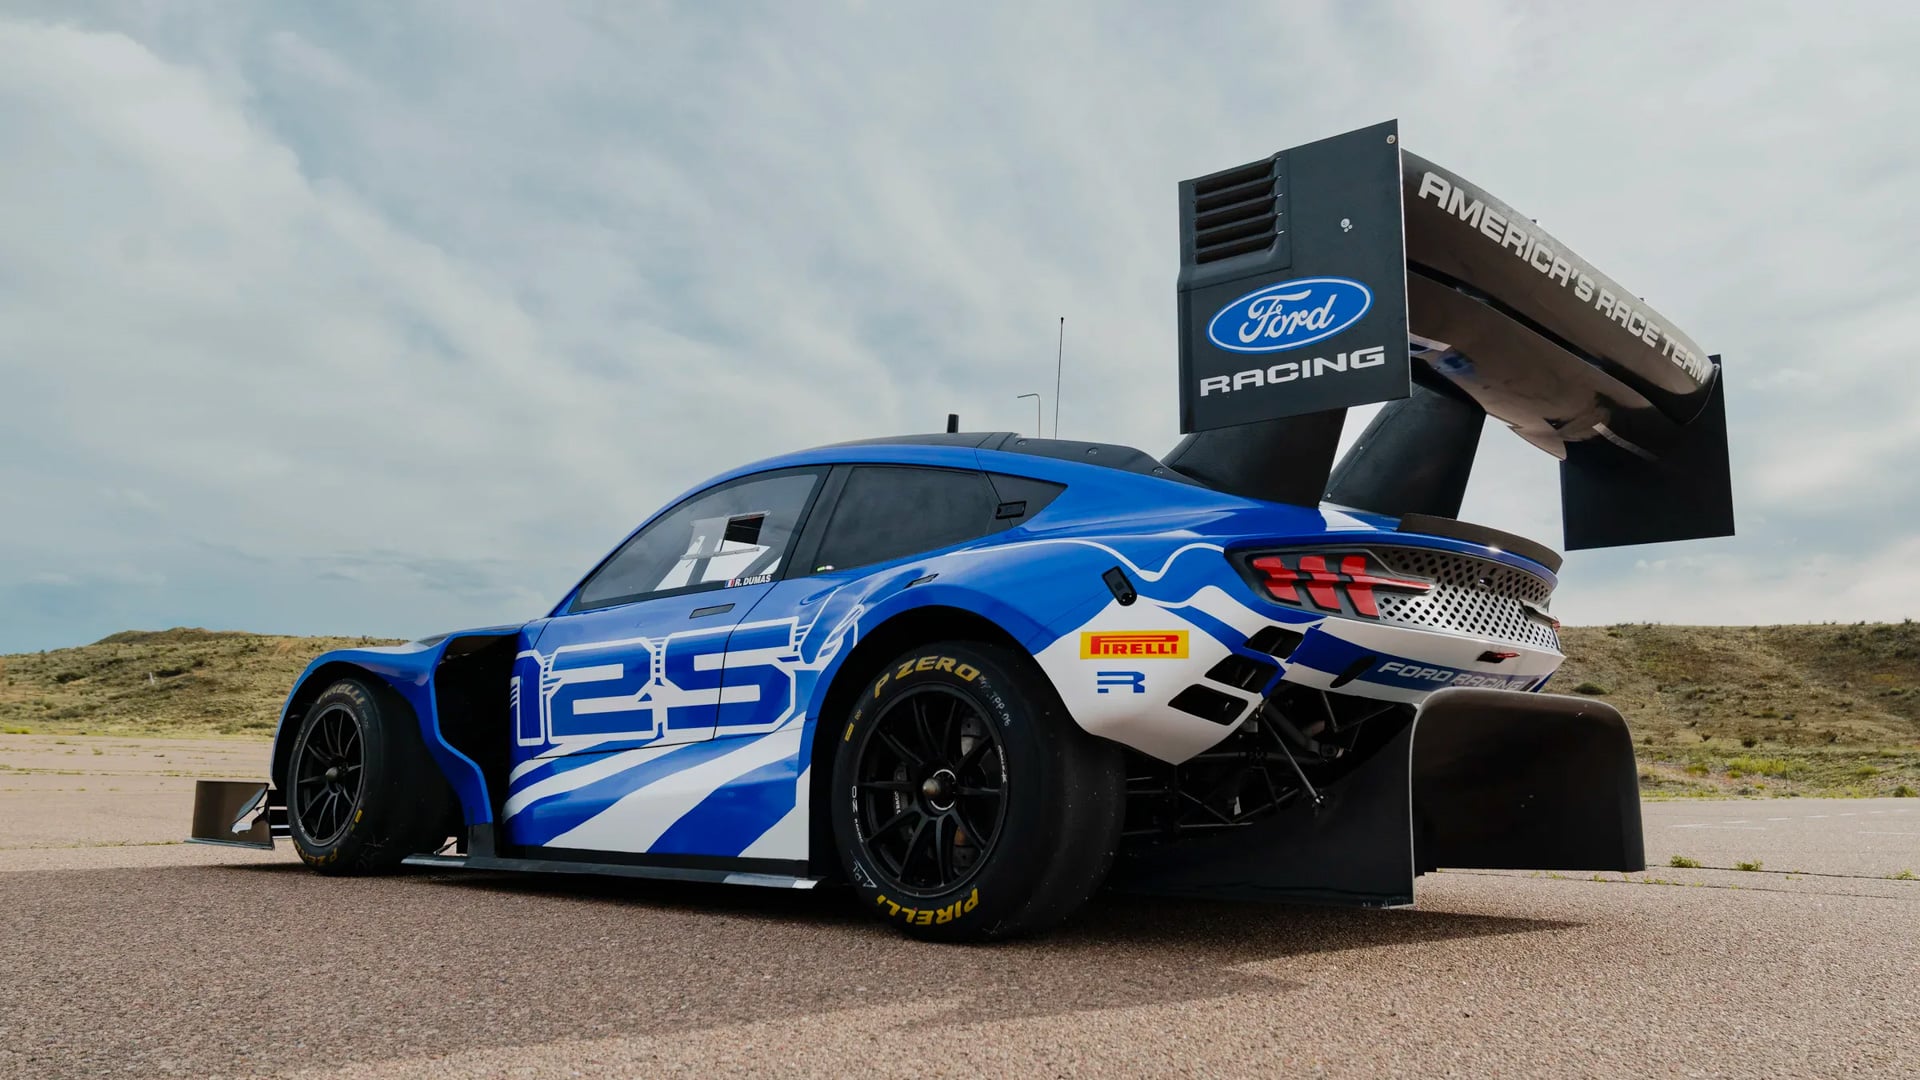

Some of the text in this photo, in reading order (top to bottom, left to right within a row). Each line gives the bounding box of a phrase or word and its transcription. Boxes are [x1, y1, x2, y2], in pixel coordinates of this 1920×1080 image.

[1418, 171, 1708, 384] AMERICA'S RACE TEAM
[1238, 289, 1338, 343] Ford
[1200, 345, 1385, 397] RACING
[734, 574, 772, 587] R. DUMAS
[1090, 635, 1179, 655] PIRELLI
[509, 616, 797, 747] 125
[874, 655, 981, 699] P ZERO
[1378, 661, 1526, 691] FORD RACING
[876, 887, 980, 926] PIRELLI
